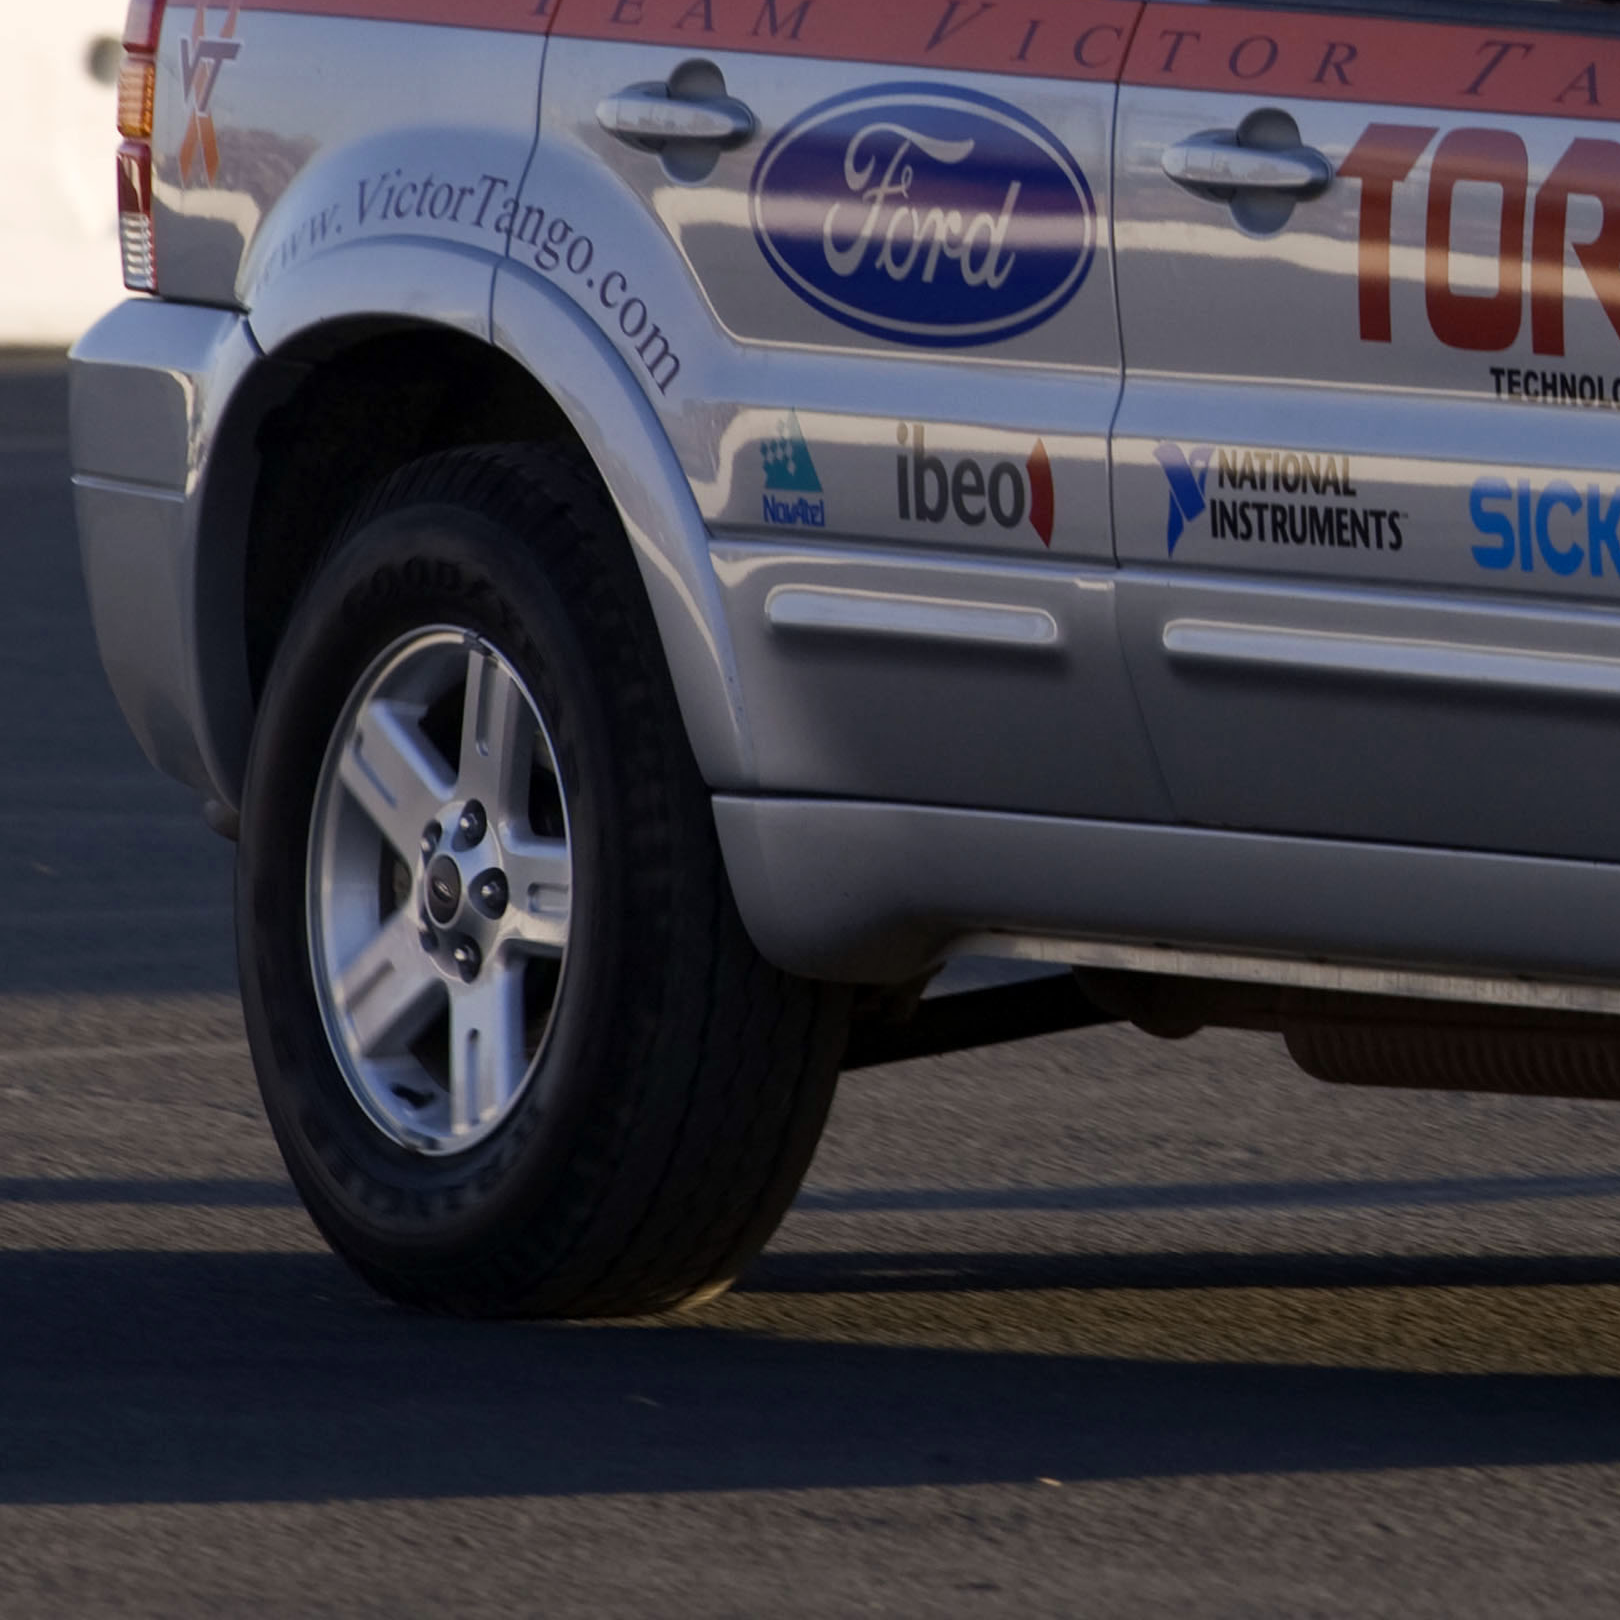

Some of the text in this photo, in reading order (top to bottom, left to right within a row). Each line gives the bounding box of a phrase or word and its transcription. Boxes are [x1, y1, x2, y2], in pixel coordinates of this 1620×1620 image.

[822, 121, 1022, 290] Ford
[896, 420, 1026, 529] ibeo
[1217, 448, 1358, 497] NATIONAL
[1209, 498, 1404, 551] INSTRUMENTS
